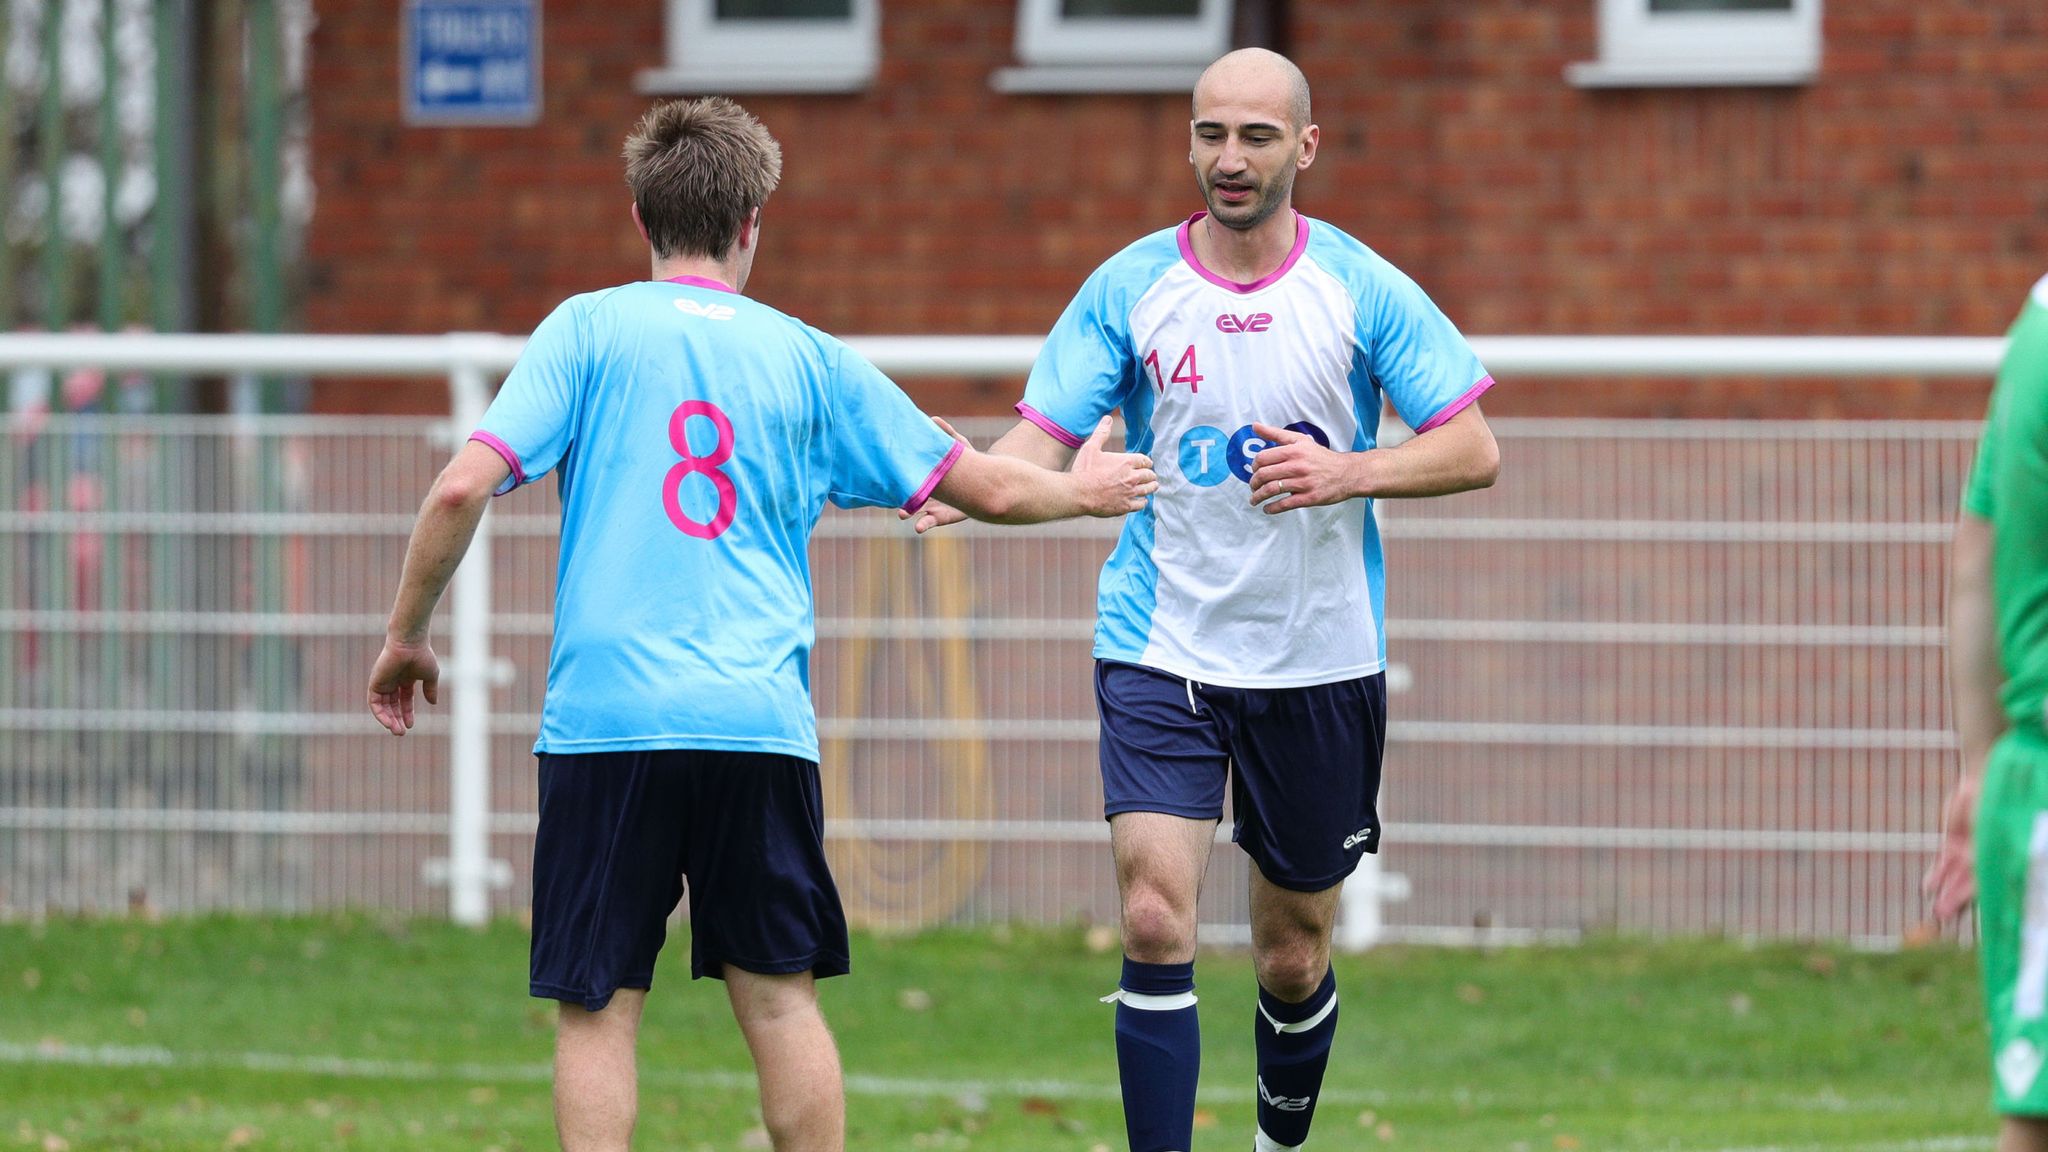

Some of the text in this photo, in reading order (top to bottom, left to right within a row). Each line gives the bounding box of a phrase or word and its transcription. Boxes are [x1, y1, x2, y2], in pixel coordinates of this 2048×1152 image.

[673, 298, 737, 321] EV2
[1215, 312, 1274, 334] EV2
[1144, 344, 1204, 394] 14
[661, 399, 738, 541] 8
[1342, 827, 1372, 850] EV2
